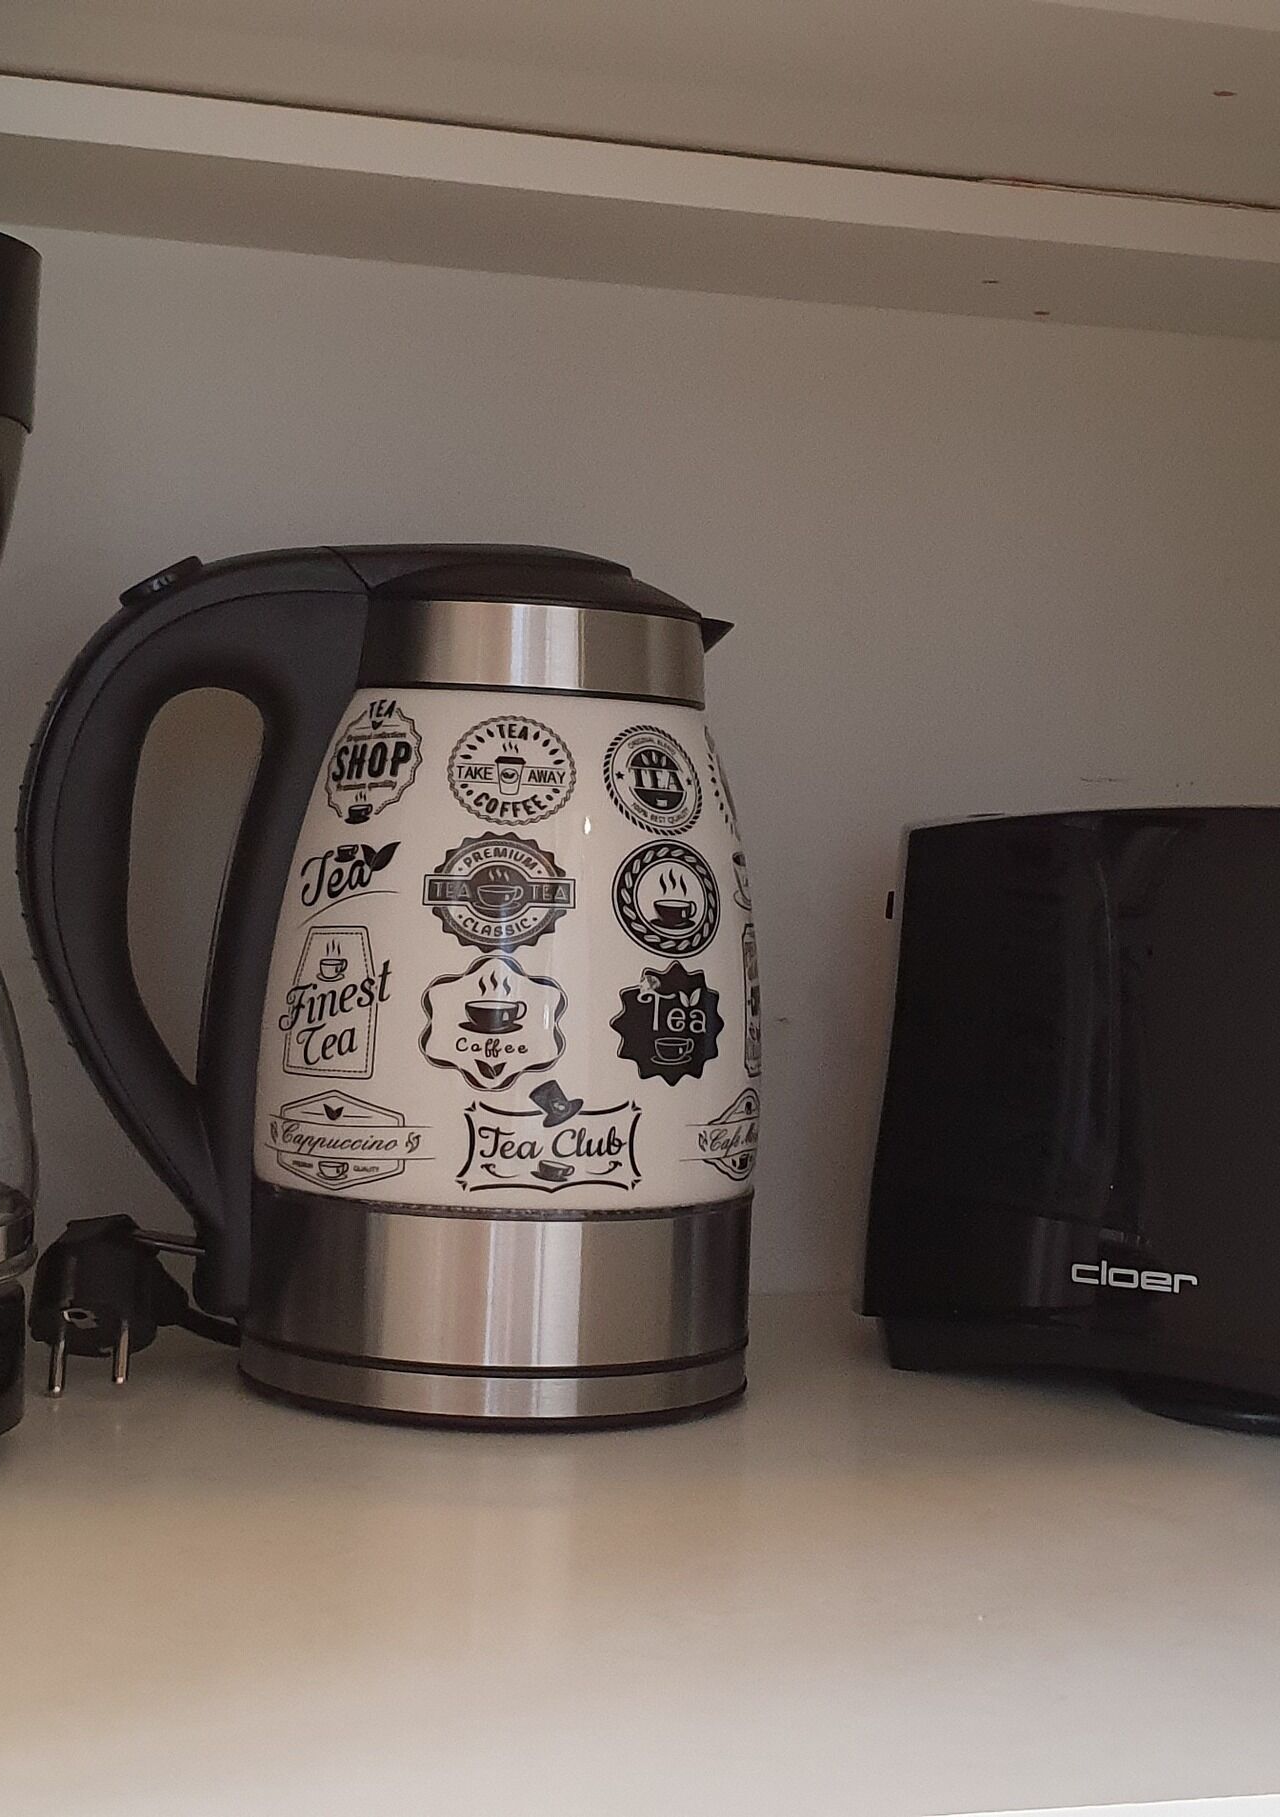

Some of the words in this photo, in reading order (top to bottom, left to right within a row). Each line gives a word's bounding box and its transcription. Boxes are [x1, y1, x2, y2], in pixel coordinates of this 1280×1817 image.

[369, 699, 397, 719] TEA
[494, 723, 530, 741] TEA
[332, 741, 411, 781] SHOP
[456, 764, 494, 782] TAKE
[527, 767, 567, 785] AWAY
[628, 766, 685, 792] TEA
[473, 792, 547, 818] COFFEE
[463, 846, 539, 870] PREMIUM
[300, 848, 372, 906] Tea
[432, 881, 470, 899] TEA
[530, 883, 567, 901] TEA
[462, 914, 534, 937] CLASSIC
[278, 959, 392, 1032] Finest
[636, 991, 708, 1034] Tea
[295, 1024, 358, 1066] Tea
[455, 1037, 529, 1058] Coffee
[282, 1122, 398, 1155] Cappuccino
[477, 1126, 543, 1161] Tea
[551, 1127, 628, 1158] Club
[1071, 1260, 1198, 1293] cloer
